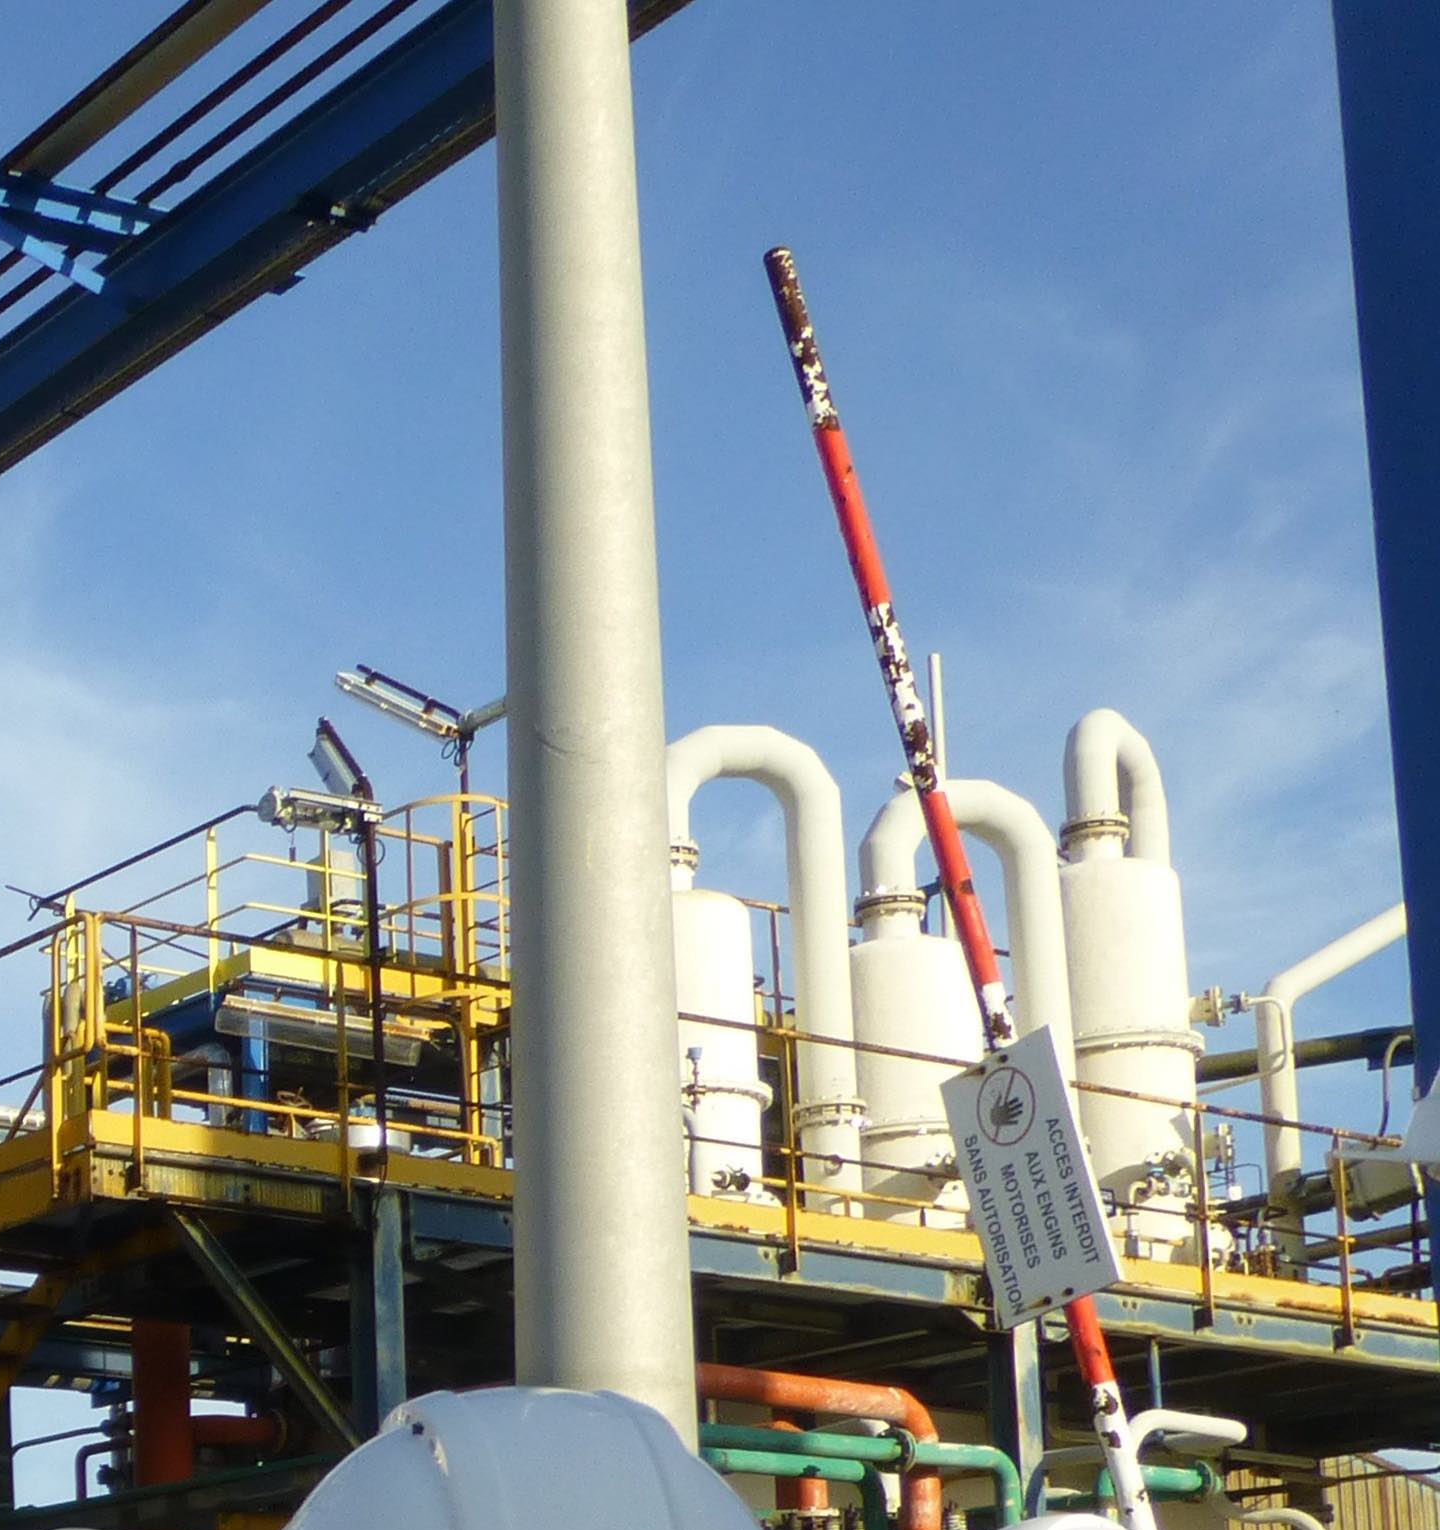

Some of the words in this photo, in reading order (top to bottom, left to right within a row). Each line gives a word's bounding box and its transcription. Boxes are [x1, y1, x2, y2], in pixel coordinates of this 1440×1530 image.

[964, 1134, 988, 1189] SANS
[978, 1186, 1027, 1317] AUTORISATION
[1000, 1163, 1040, 1270] MOTORISES
[1024, 1151, 1049, 1189] AUX
[1039, 1190, 1068, 1261] ENGINS
[1045, 1117, 1073, 1181] ACCES
[1062, 1182, 1102, 1265] INTERDIT
